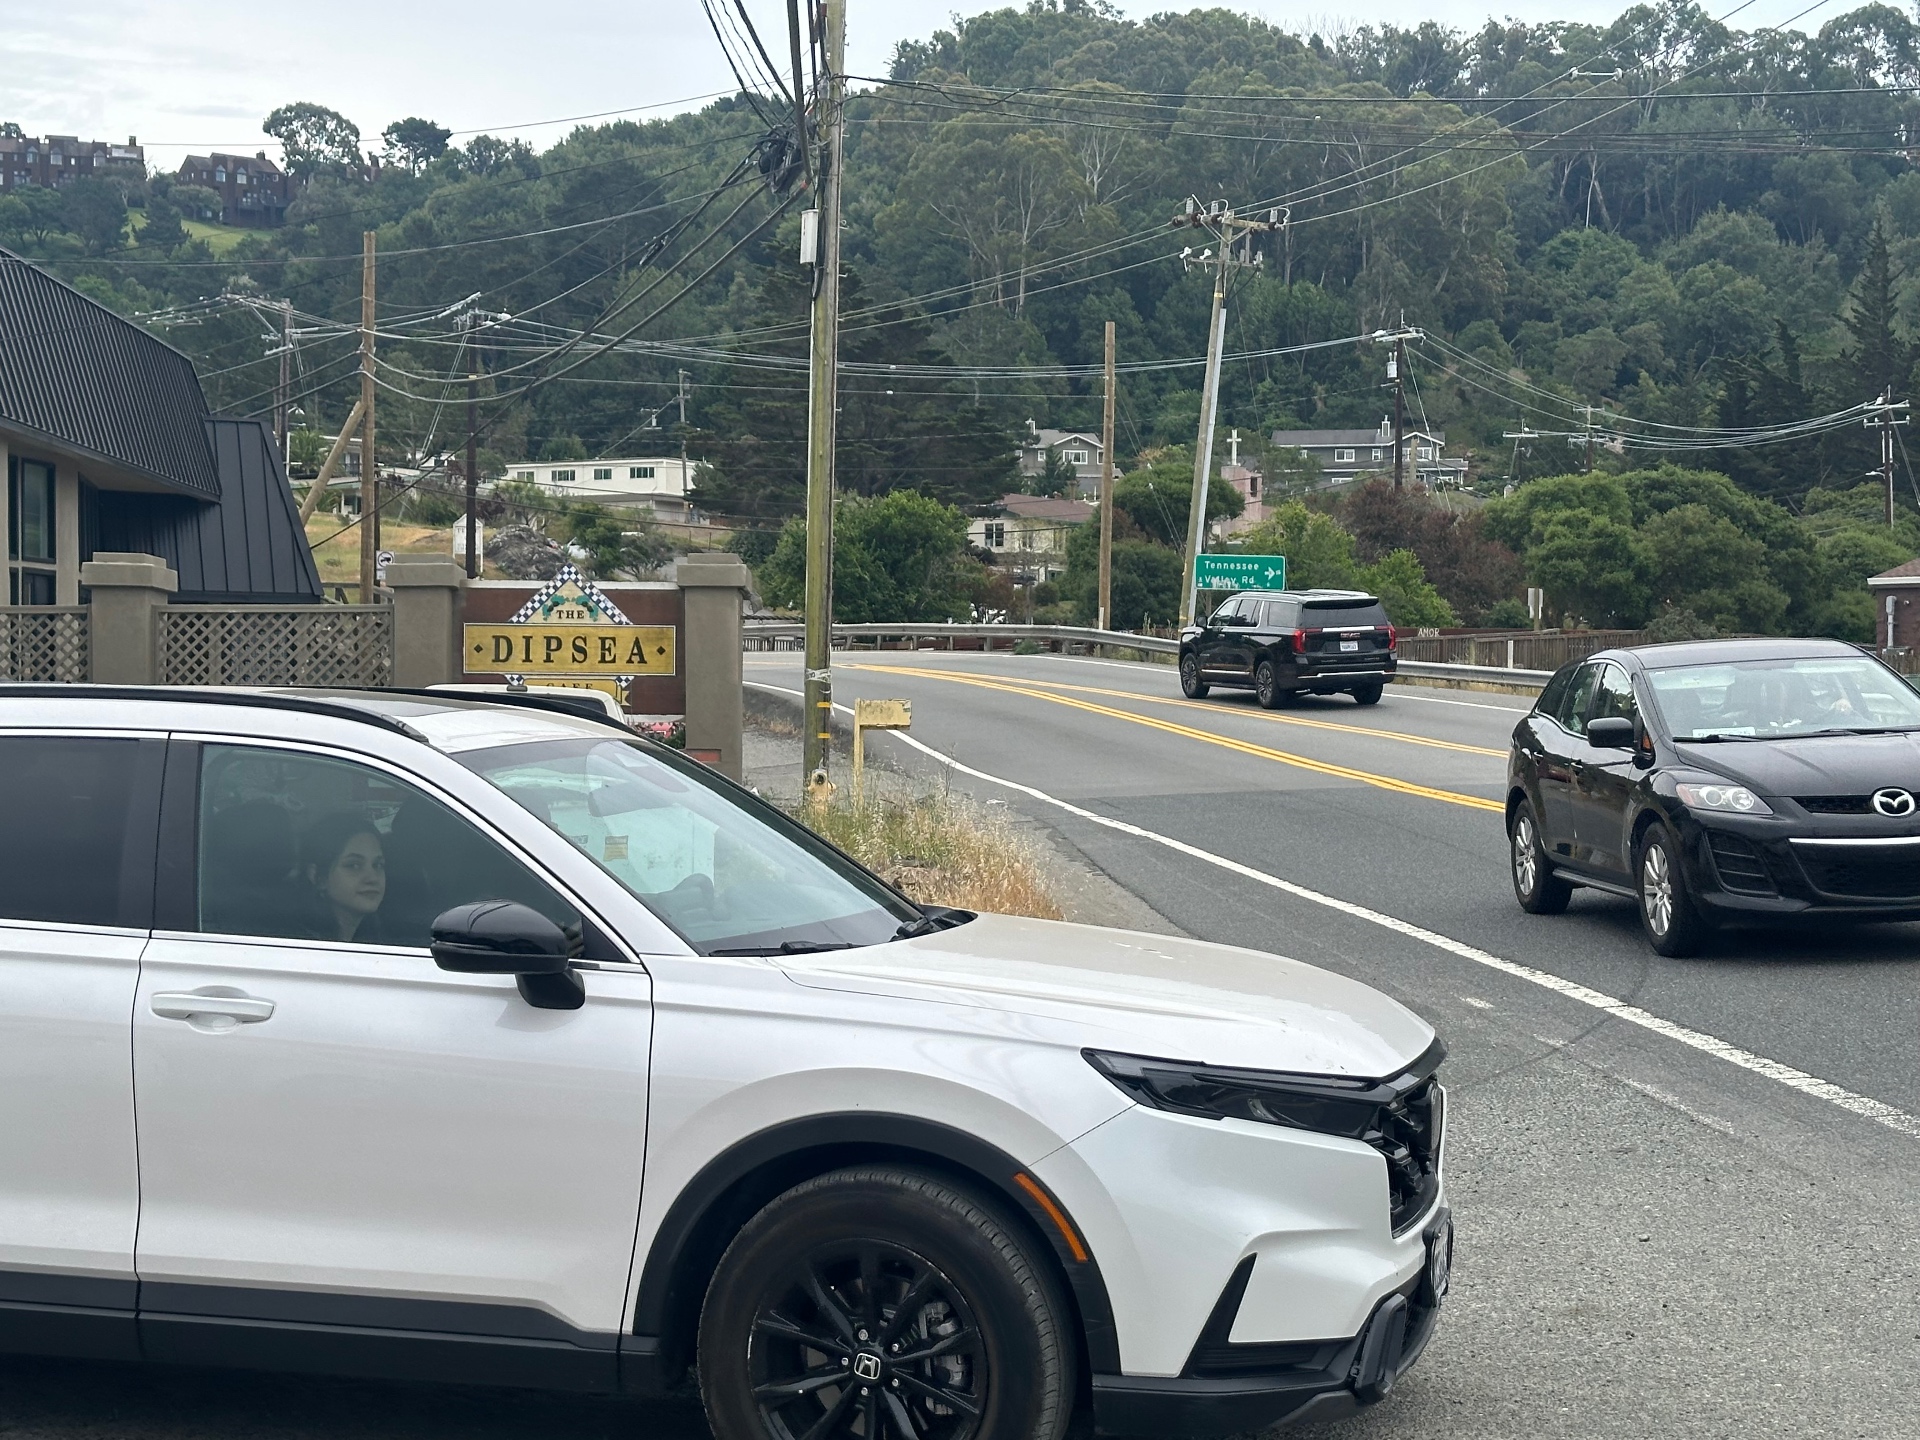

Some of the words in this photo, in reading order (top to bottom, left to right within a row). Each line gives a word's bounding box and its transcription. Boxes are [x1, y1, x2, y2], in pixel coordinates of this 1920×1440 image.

[1204, 561, 1259, 570] Tennessee
[1241, 576, 1255, 584] Rd
[556, 610, 585, 619] THE
[491, 635, 648, 664] DIPSEA
